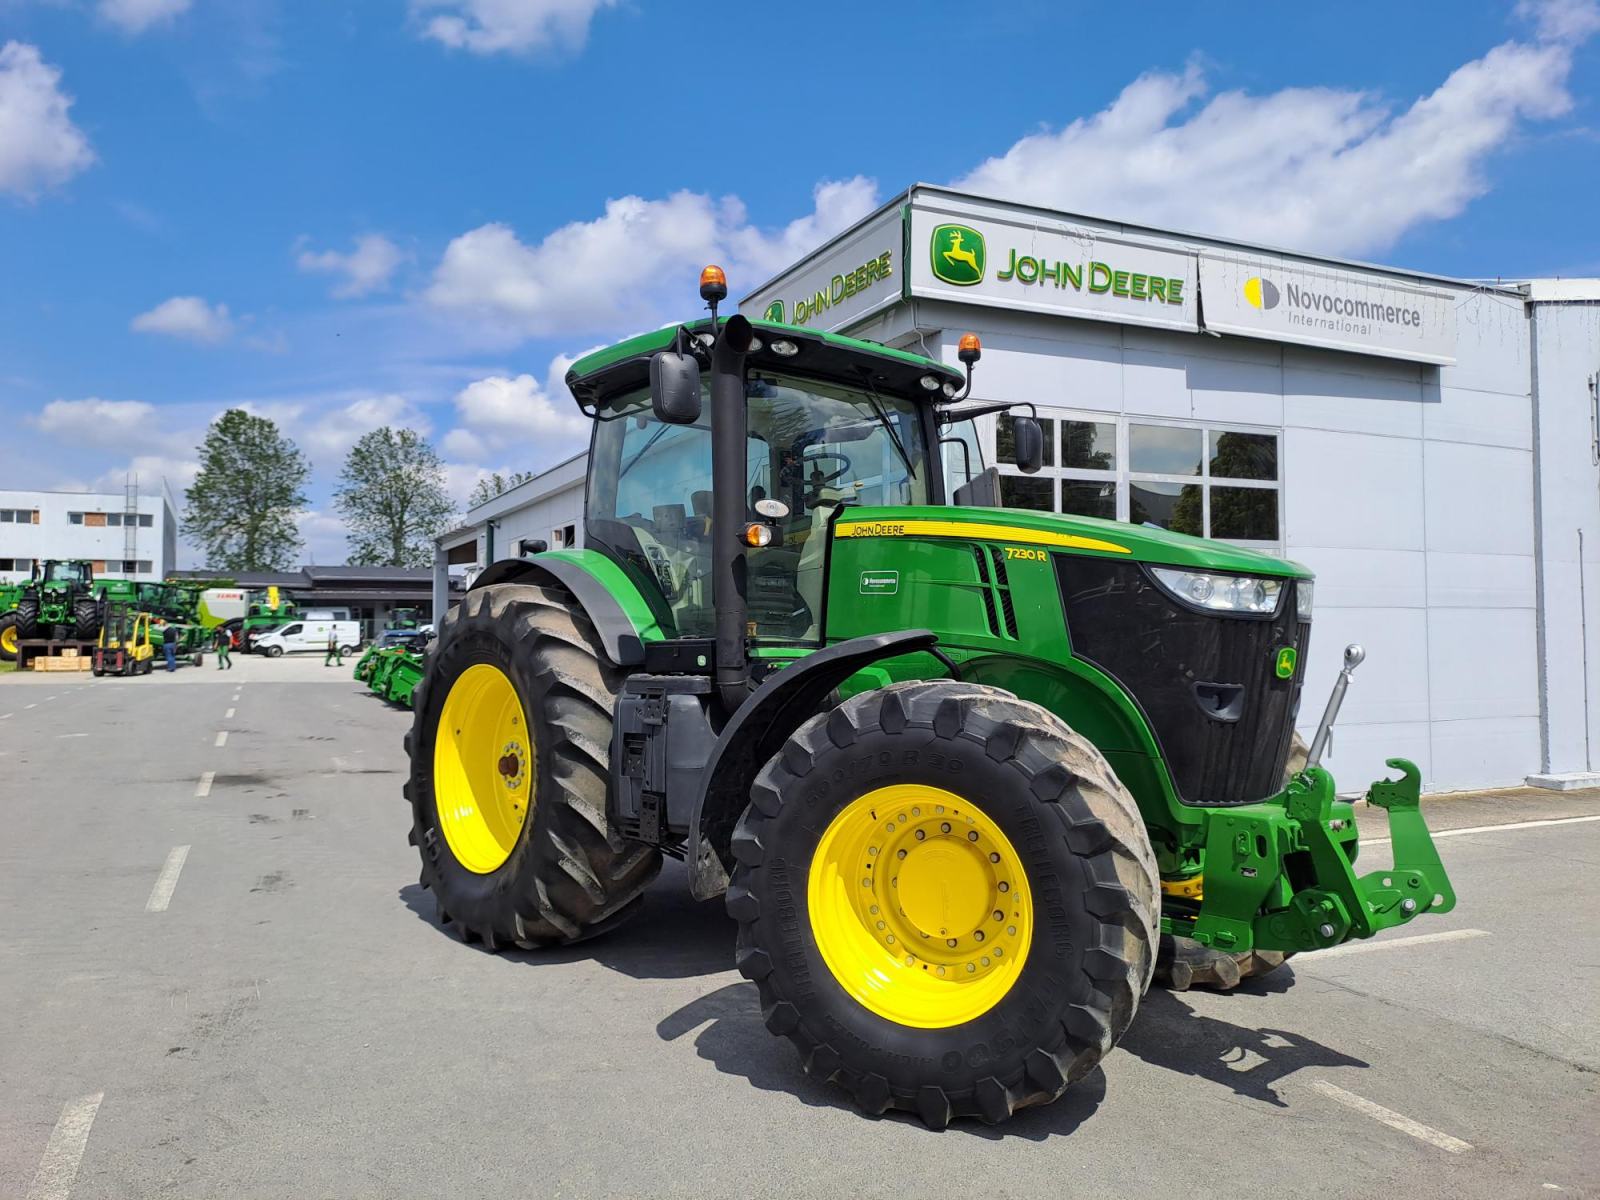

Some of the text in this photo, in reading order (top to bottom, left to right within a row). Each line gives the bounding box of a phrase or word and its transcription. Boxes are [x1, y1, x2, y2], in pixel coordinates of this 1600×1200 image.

[792, 249, 893, 325] JOHN DEERE
[997, 248, 1185, 304] JOHN DEERE
[1286, 282, 1421, 327] Novocommerce
[1288, 311, 1372, 336] International
[851, 523, 905, 536] JOHN DEERE
[1004, 547, 1048, 562] 7230 R
